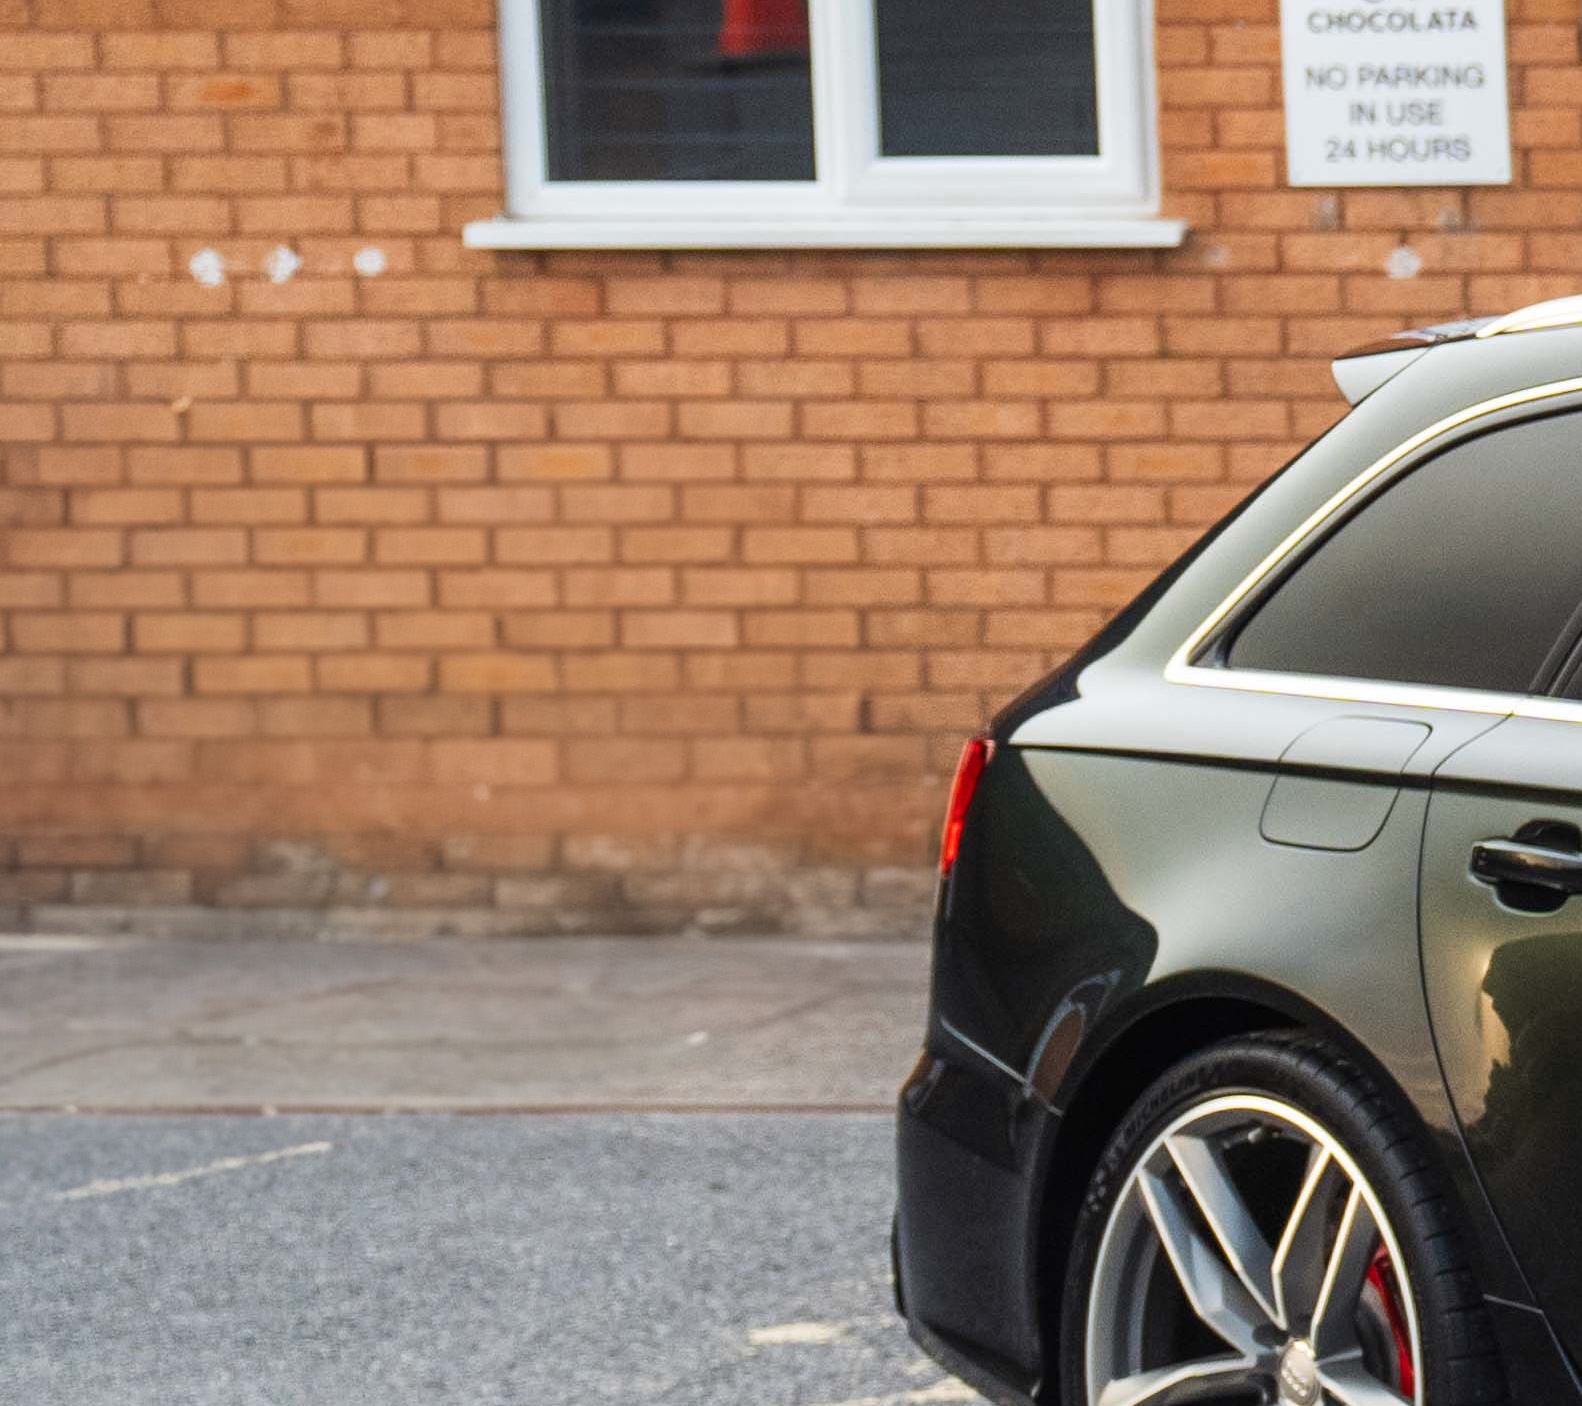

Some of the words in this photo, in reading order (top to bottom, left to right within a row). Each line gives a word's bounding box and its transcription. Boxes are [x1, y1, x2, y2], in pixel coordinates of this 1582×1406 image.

[1307, 8, 1479, 34] CHOCOLATA
[1305, 65, 1348, 91] NO
[1357, 64, 1486, 91] PARKING
[1349, 101, 1377, 126] IN
[1386, 100, 1444, 126] USE
[1325, 138, 1358, 163] 24
[1367, 136, 1473, 163] HOURS
